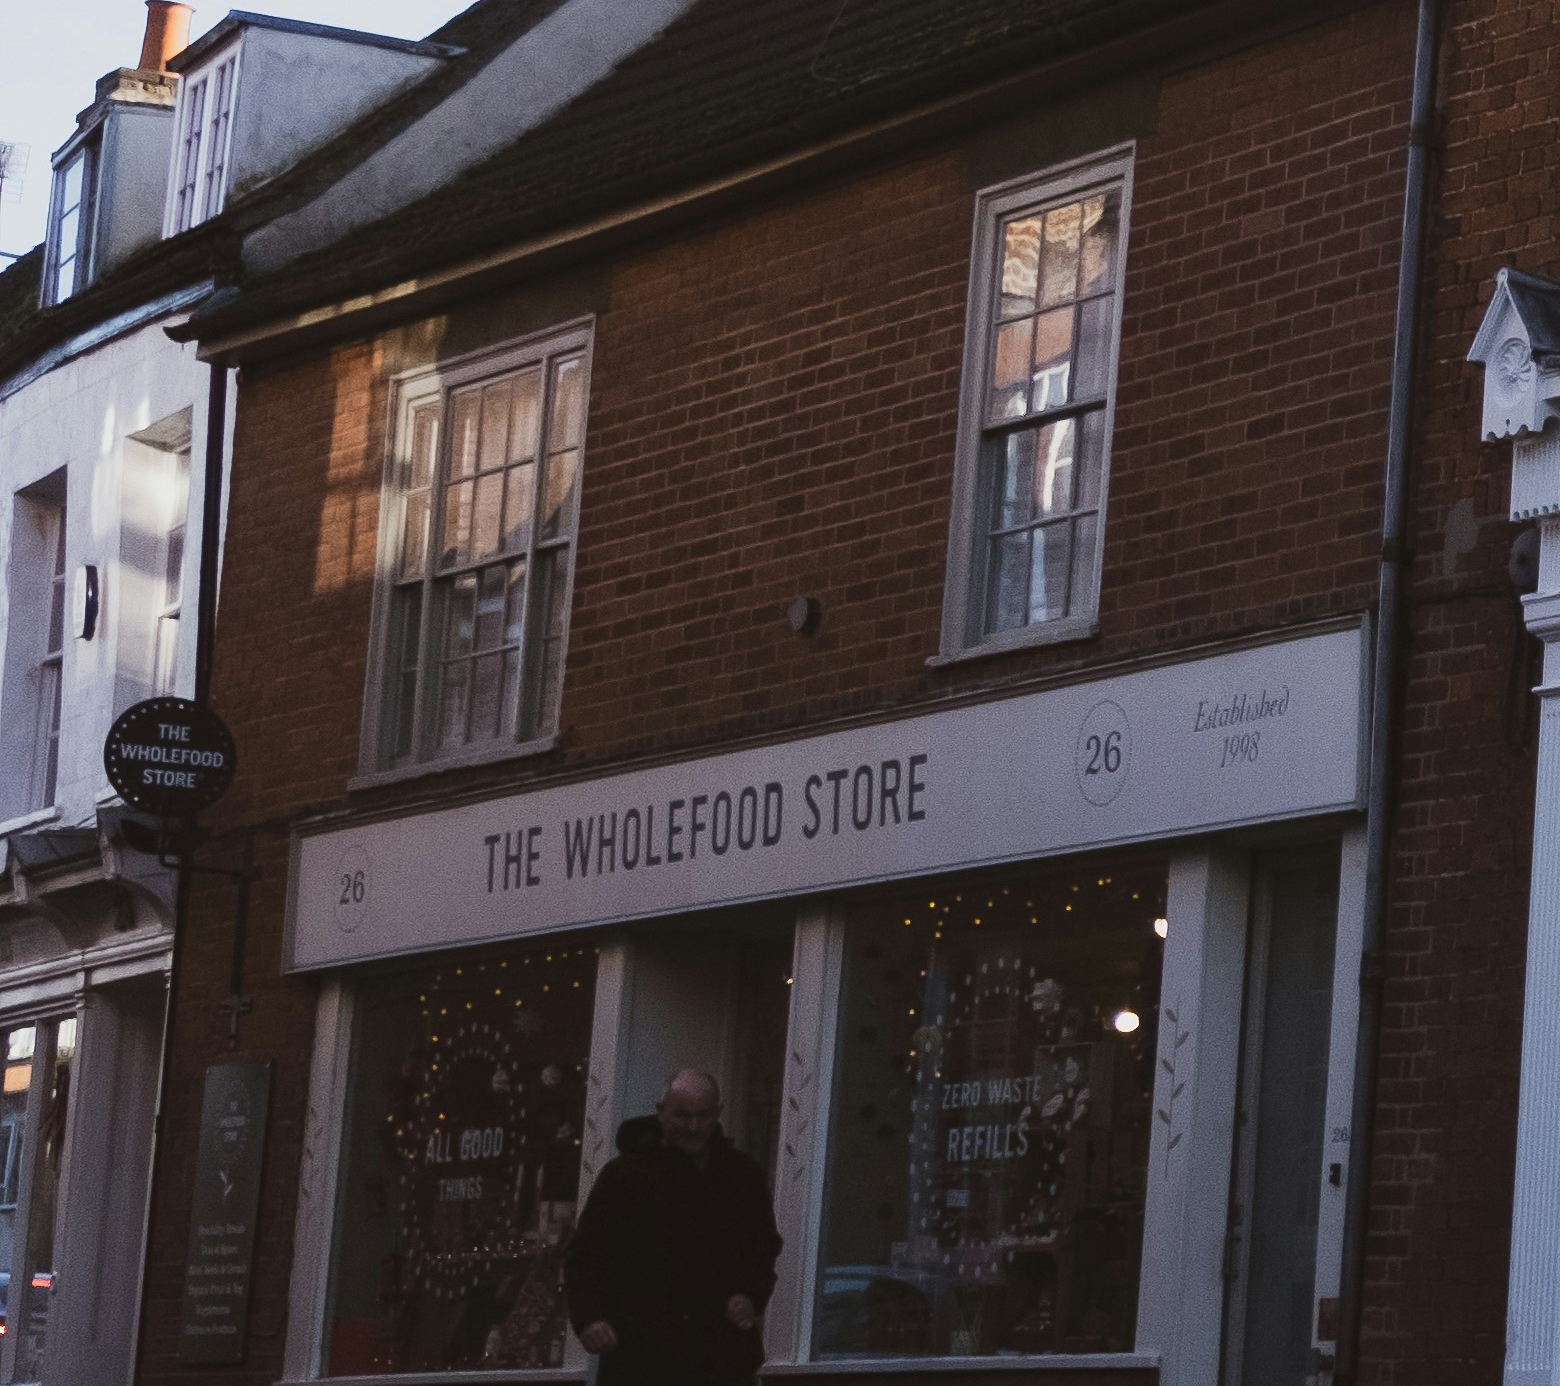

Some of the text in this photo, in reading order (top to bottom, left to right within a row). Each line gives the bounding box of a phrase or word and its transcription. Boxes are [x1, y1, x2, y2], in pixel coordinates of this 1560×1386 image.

[1193, 685, 1290, 733] Established
[158, 724, 191, 741] THE
[1220, 731, 1260, 768] 1998
[120, 743, 224, 767] WHOLEFOOD
[1085, 731, 1121, 776] 26
[143, 769, 197, 788] STORE
[485, 753, 928, 893] THE WHOLEFOOD STORE
[340, 871, 365, 905] 26
[942, 1076, 1043, 1110] ZERO WASTE
[424, 1125, 504, 1166] ALL GOOD
[947, 1122, 1030, 1163] REFILLS
[1331, 1125, 1348, 1143] 26
[437, 1175, 484, 1203] THINGS
